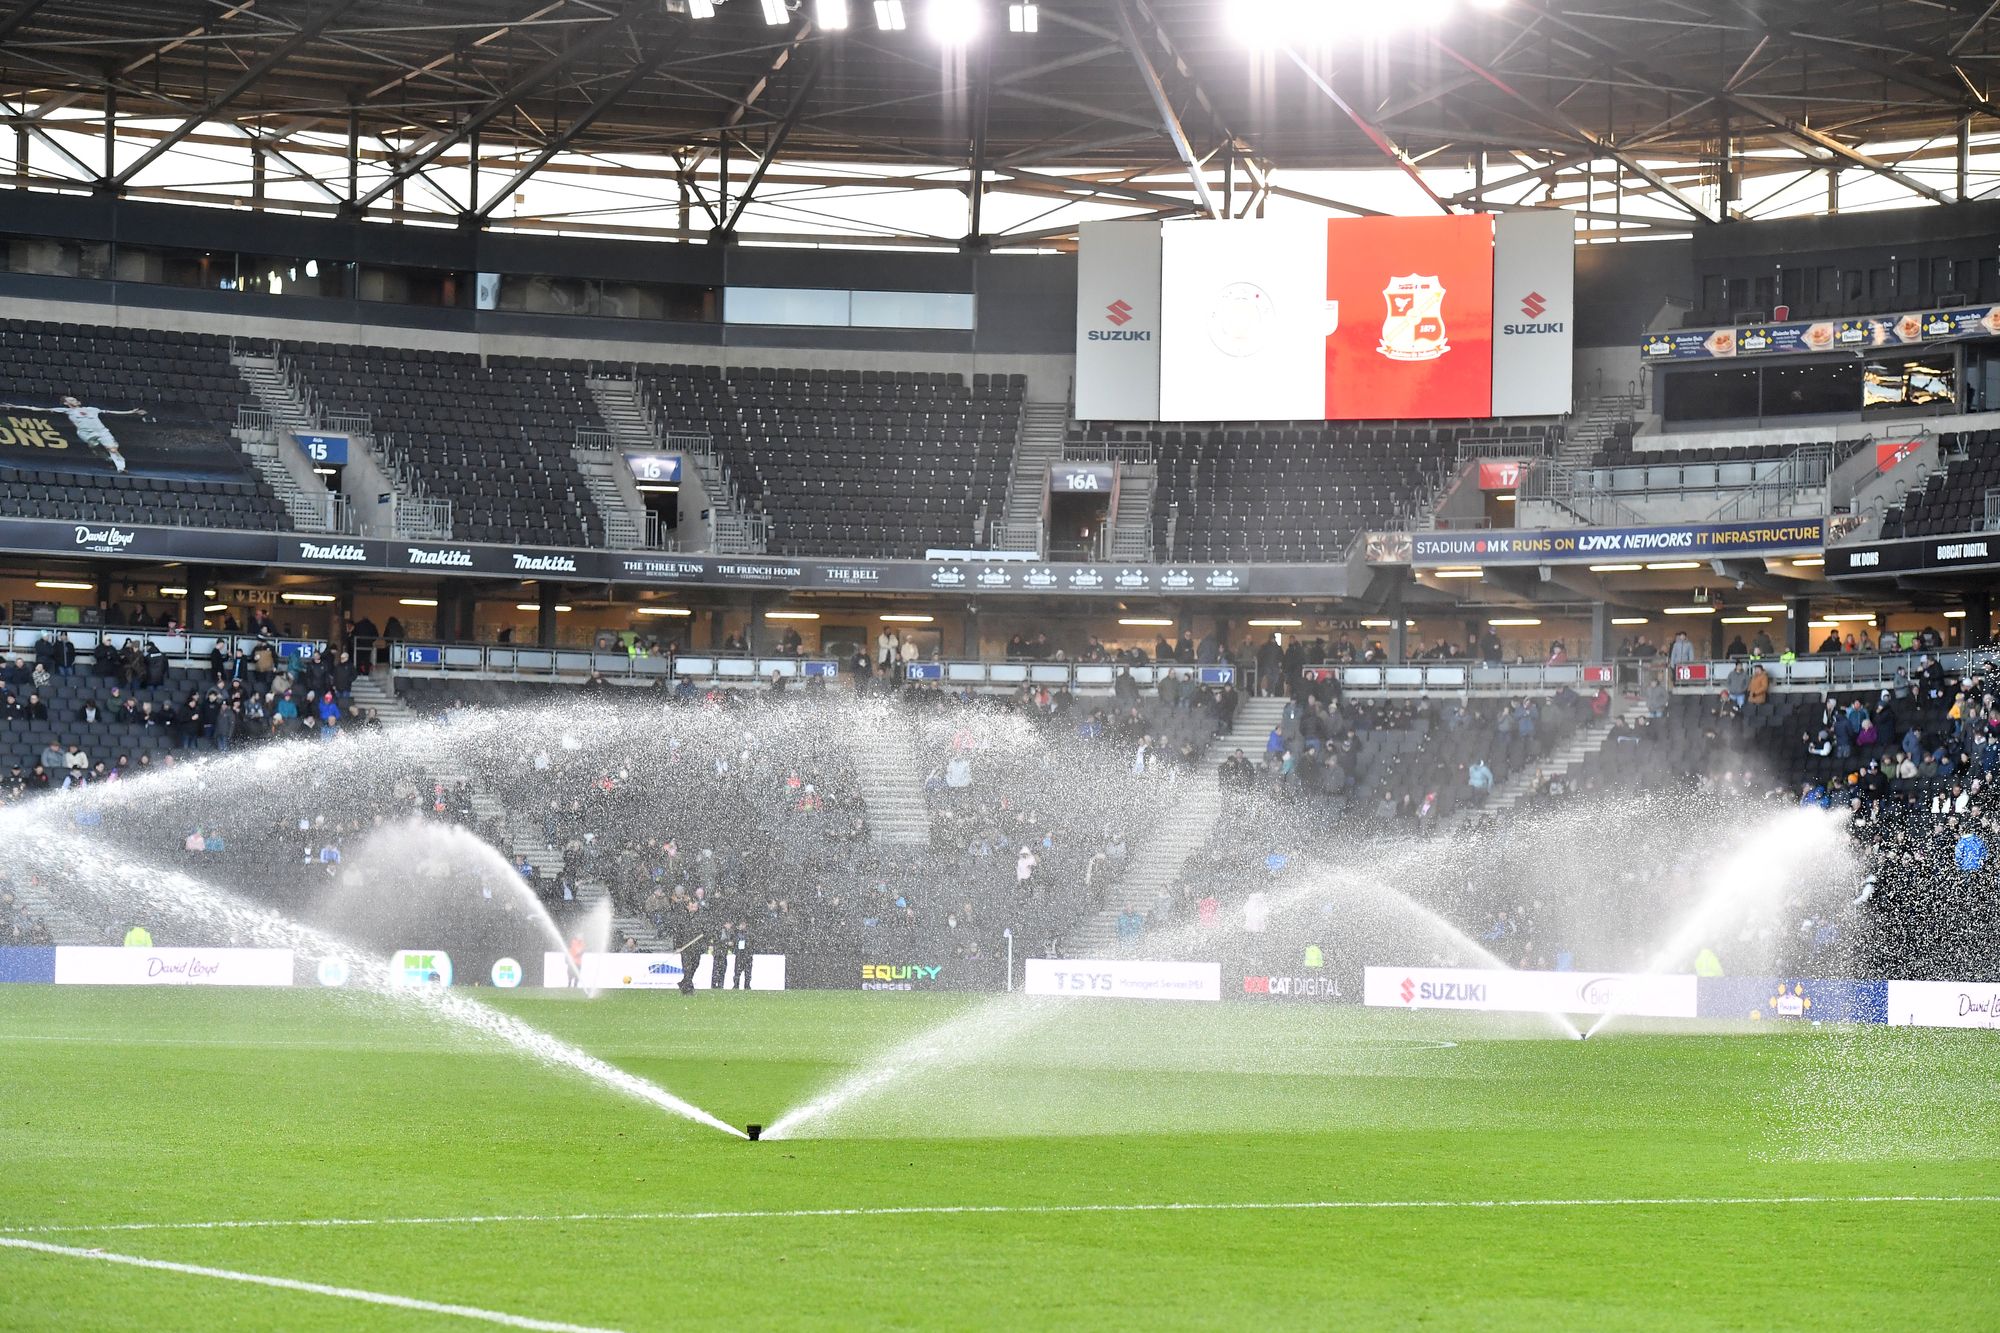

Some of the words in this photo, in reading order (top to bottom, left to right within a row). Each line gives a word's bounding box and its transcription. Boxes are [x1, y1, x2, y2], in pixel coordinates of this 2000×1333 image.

[1088, 331, 1151, 341] SUZUKI
[1504, 323, 1563, 335] SUZUKI
[8, 416, 54, 431] MK
[308, 444, 327, 460] 15
[642, 463, 661, 478] 16
[1500, 470, 1519, 485] 17
[1066, 474, 1098, 489] 16A
[75, 526, 109, 544] David
[107, 527, 135, 546] Lloyd
[1416, 540, 1475, 554] STADIUM
[1487, 539, 1509, 552] MK
[1512, 539, 1551, 552] RUNS
[1554, 538, 1575, 550] ON
[1578, 535, 1621, 550] LYNX
[1623, 532, 1693, 549] NETWORKS
[1697, 532, 1709, 545] IT
[1711, 526, 1820, 544] INFRASTRUCTURE
[1937, 545, 1963, 560] BOBCAT
[1963, 542, 1988, 558] DIGITAL
[1850, 553, 1861, 567] MK
[1861, 551, 1879, 566] DONS
[623, 561, 643, 570] THE
[644, 562, 676, 572] THREE
[677, 564, 703, 573] TUNS
[717, 565, 735, 573] THE
[736, 566, 772, 575] FRENCH
[773, 567, 801, 576] HORN
[827, 569, 849, 578] THE
[852, 570, 879, 580] BELL
[248, 590, 279, 603] EXIT
[298, 646, 312, 658] 15
[410, 651, 422, 662] 15
[822, 666, 835, 677] 16
[911, 667, 924, 678] 16
[1218, 671, 1231, 683] 17
[1599, 670, 1610, 681] 18
[1678, 668, 1691, 680] 18
[147, 957, 187, 977] David
[188, 957, 220, 977] Lloyd
[404, 955, 436, 969] MK
[862, 964, 942, 981] EQUITY
[862, 983, 911, 991] ENERGIES
[1054, 971, 1113, 991] TSYS
[1294, 977, 1342, 996] DIGITAL
[1420, 982, 1486, 1002] SUZUKI
[1958, 993, 1990, 1016] David
